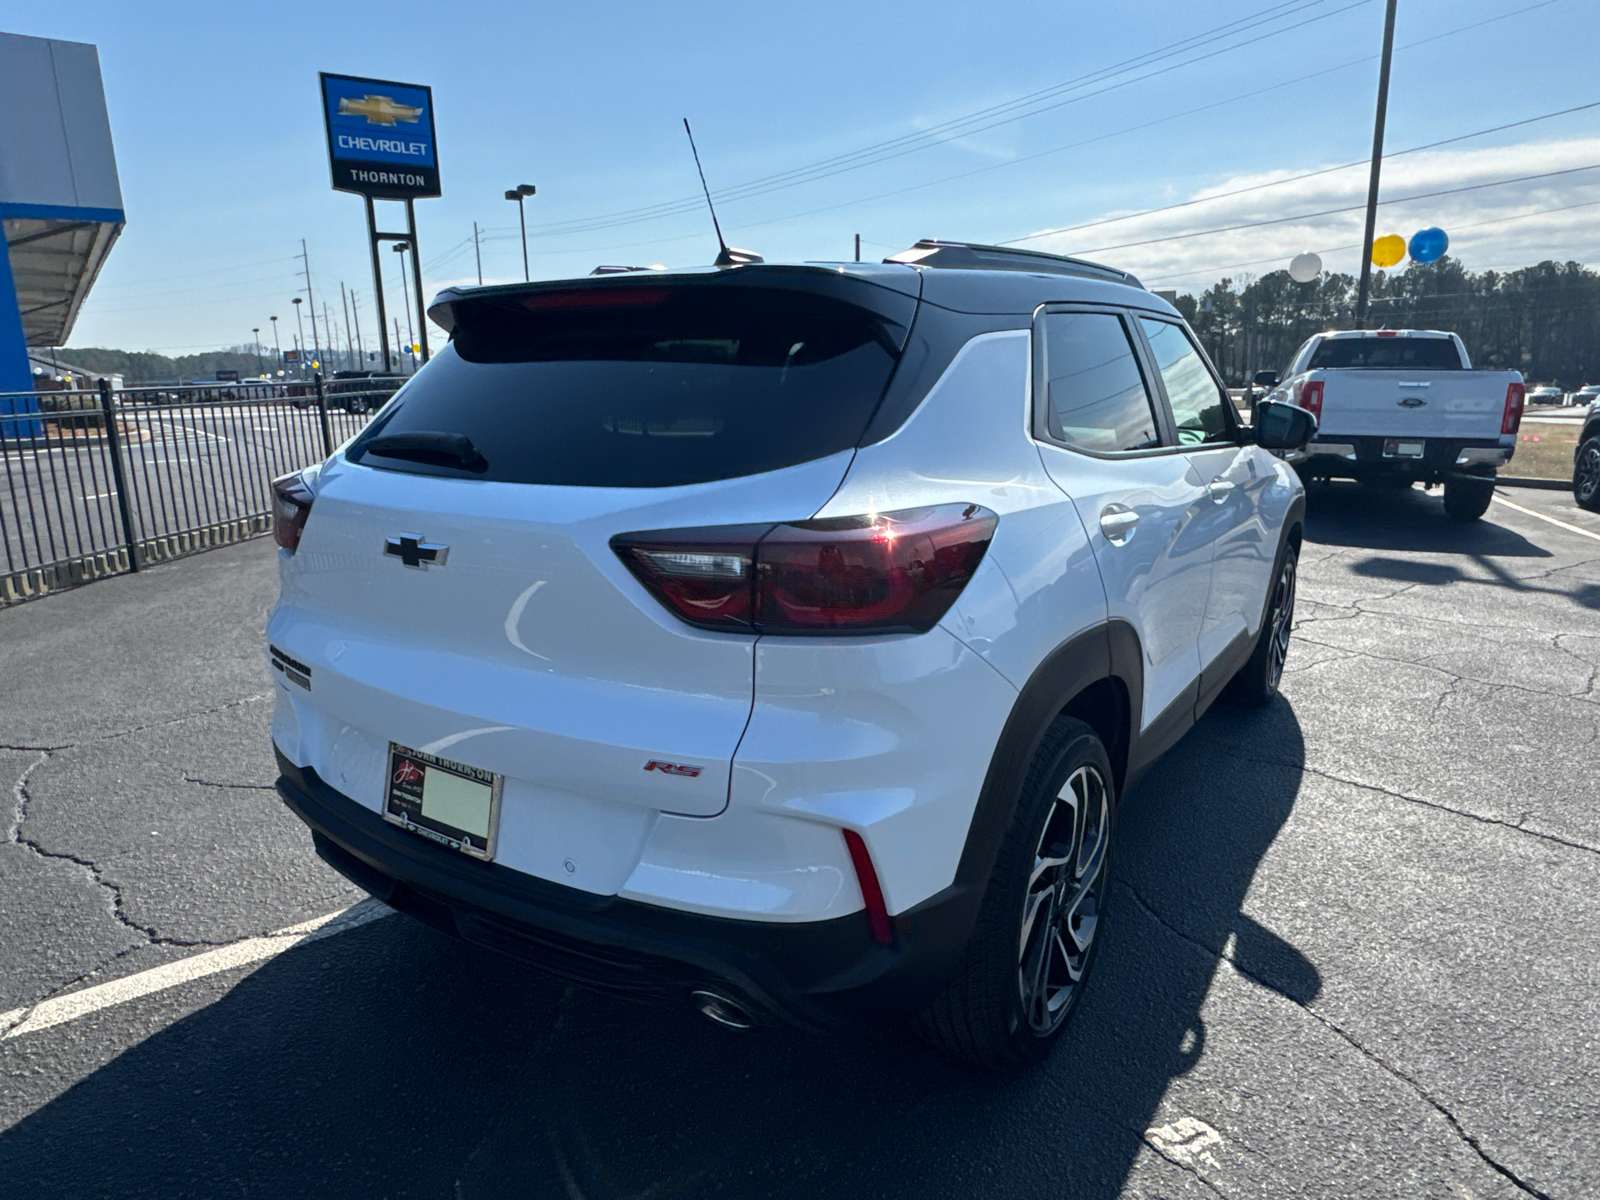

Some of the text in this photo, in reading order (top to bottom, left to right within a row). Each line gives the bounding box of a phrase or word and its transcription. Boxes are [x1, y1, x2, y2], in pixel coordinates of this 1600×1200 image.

[338, 135, 427, 155] CHEVROLET
[350, 169, 425, 186] THORNTON
[643, 759, 704, 778] RS
